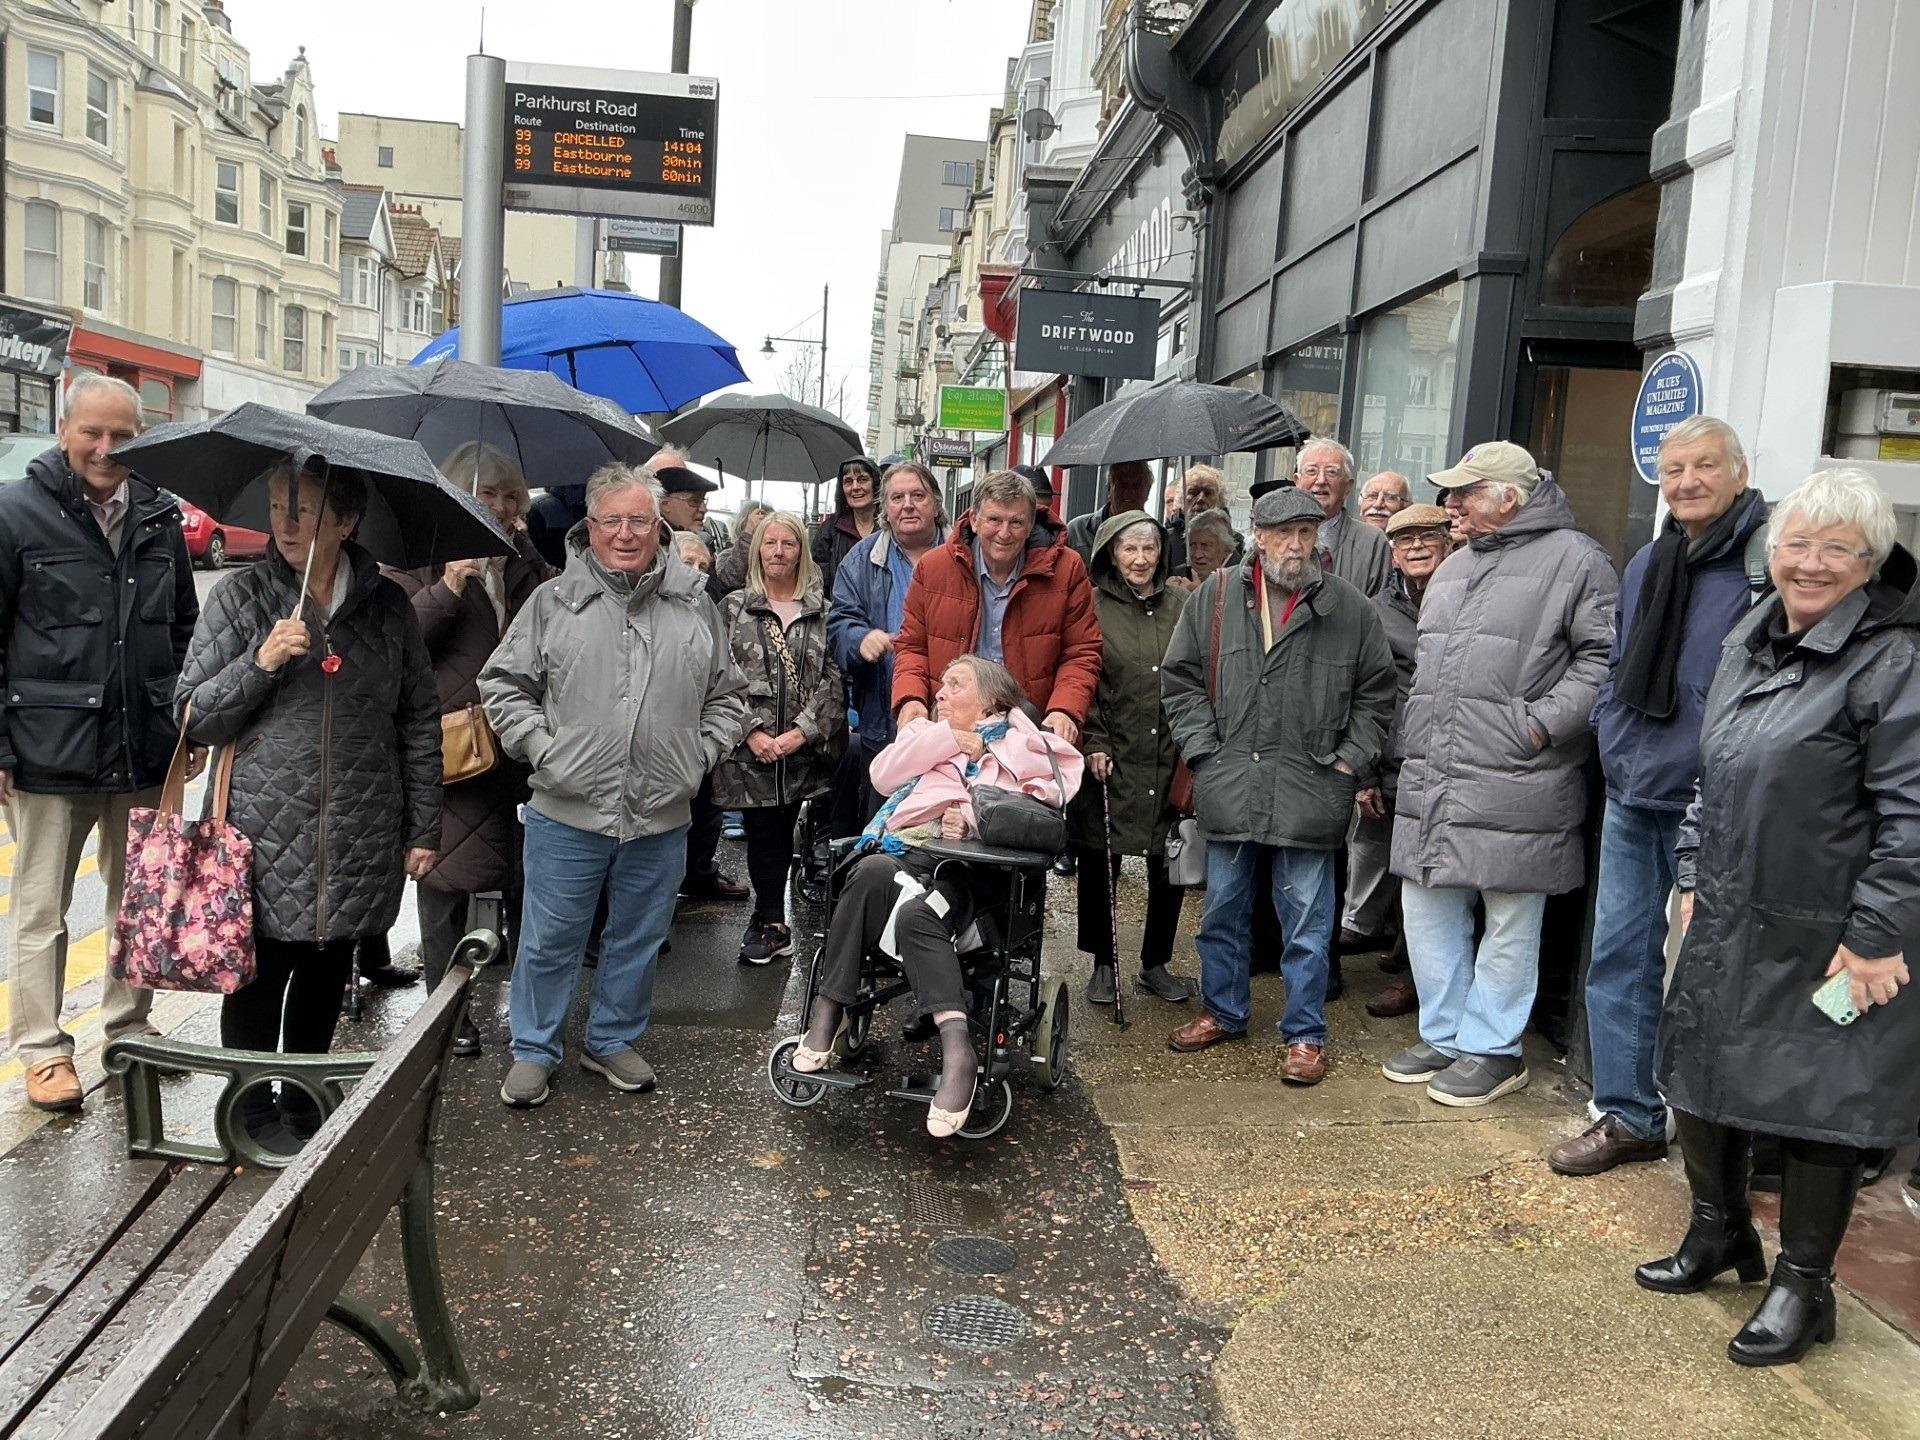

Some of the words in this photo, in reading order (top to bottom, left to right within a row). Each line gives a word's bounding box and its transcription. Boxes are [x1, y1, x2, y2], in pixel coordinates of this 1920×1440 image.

[515, 93, 590, 113] Parkhurst
[595, 100, 637, 117] Road
[514, 115, 542, 127] Route
[575, 120, 636, 134] Destination
[679, 128, 705, 140] Time
[515, 129, 532, 141] 99
[554, 132, 625, 149] CANCELLED
[664, 141, 702, 154] 14:04
[515, 143, 531, 155] 99
[553, 147, 632, 164] Eastbourne
[663, 156, 702, 169] 30min
[515, 158, 531, 170] 99
[553, 162, 632, 178] Eastbourne
[662, 171, 701, 184] 60min
[677, 203, 710, 215] 46090
[1080, 311, 1095, 323] The
[1041, 325, 1134, 344] DRIFTWOOD
[1656, 375, 1681, 389] BLUES
[1647, 388, 1688, 403] UNLIMITED
[1645, 401, 1685, 416] MAGAZINE
